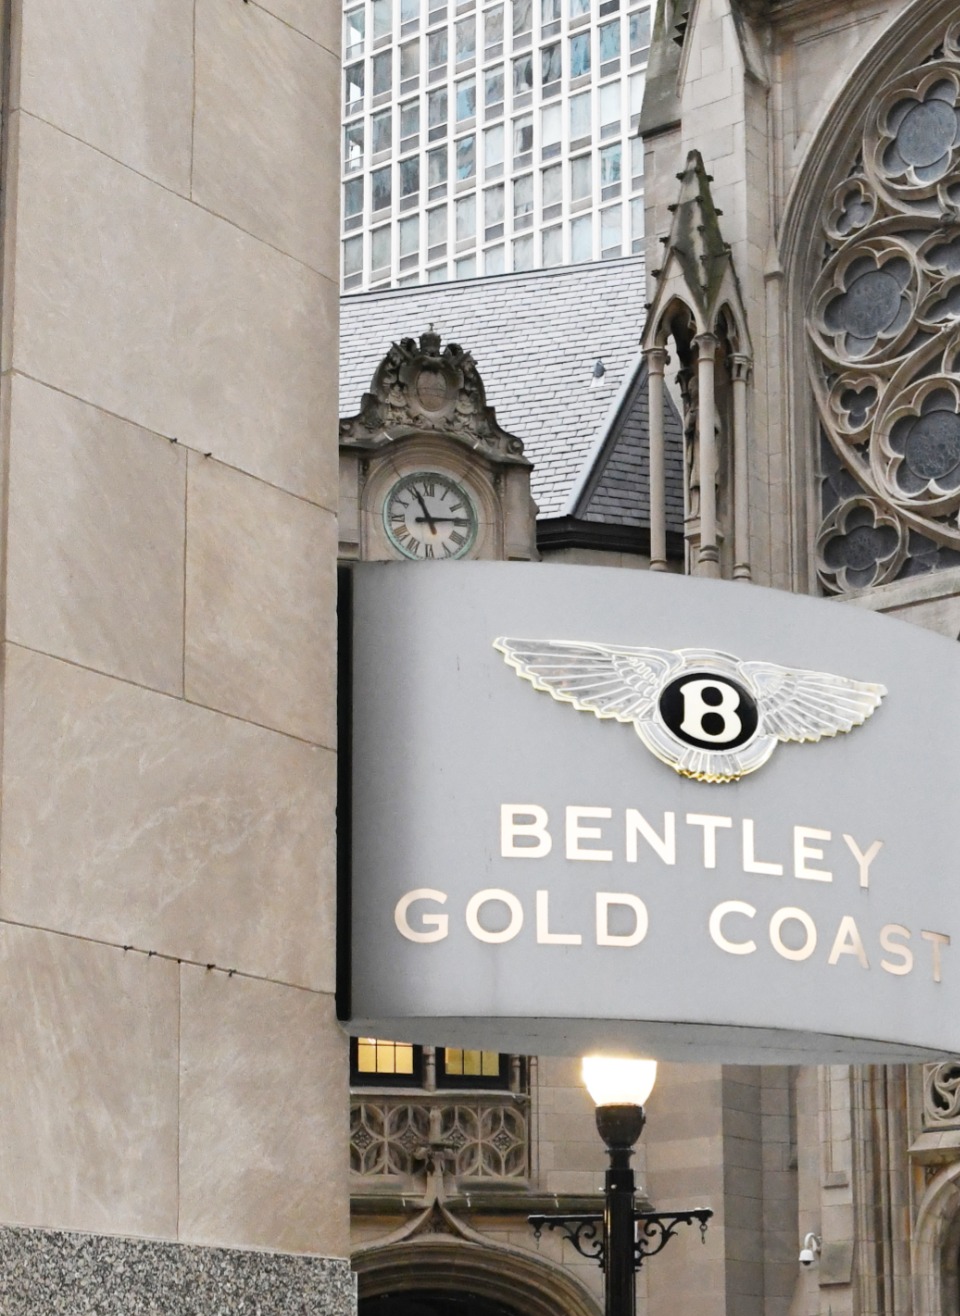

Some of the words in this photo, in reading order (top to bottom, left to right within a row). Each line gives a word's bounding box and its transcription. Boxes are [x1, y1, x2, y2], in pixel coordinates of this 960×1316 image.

[500, 803, 884, 888] BENTLEY
[394, 888, 649, 947] GOLD
[708, 900, 952, 982] COAST
